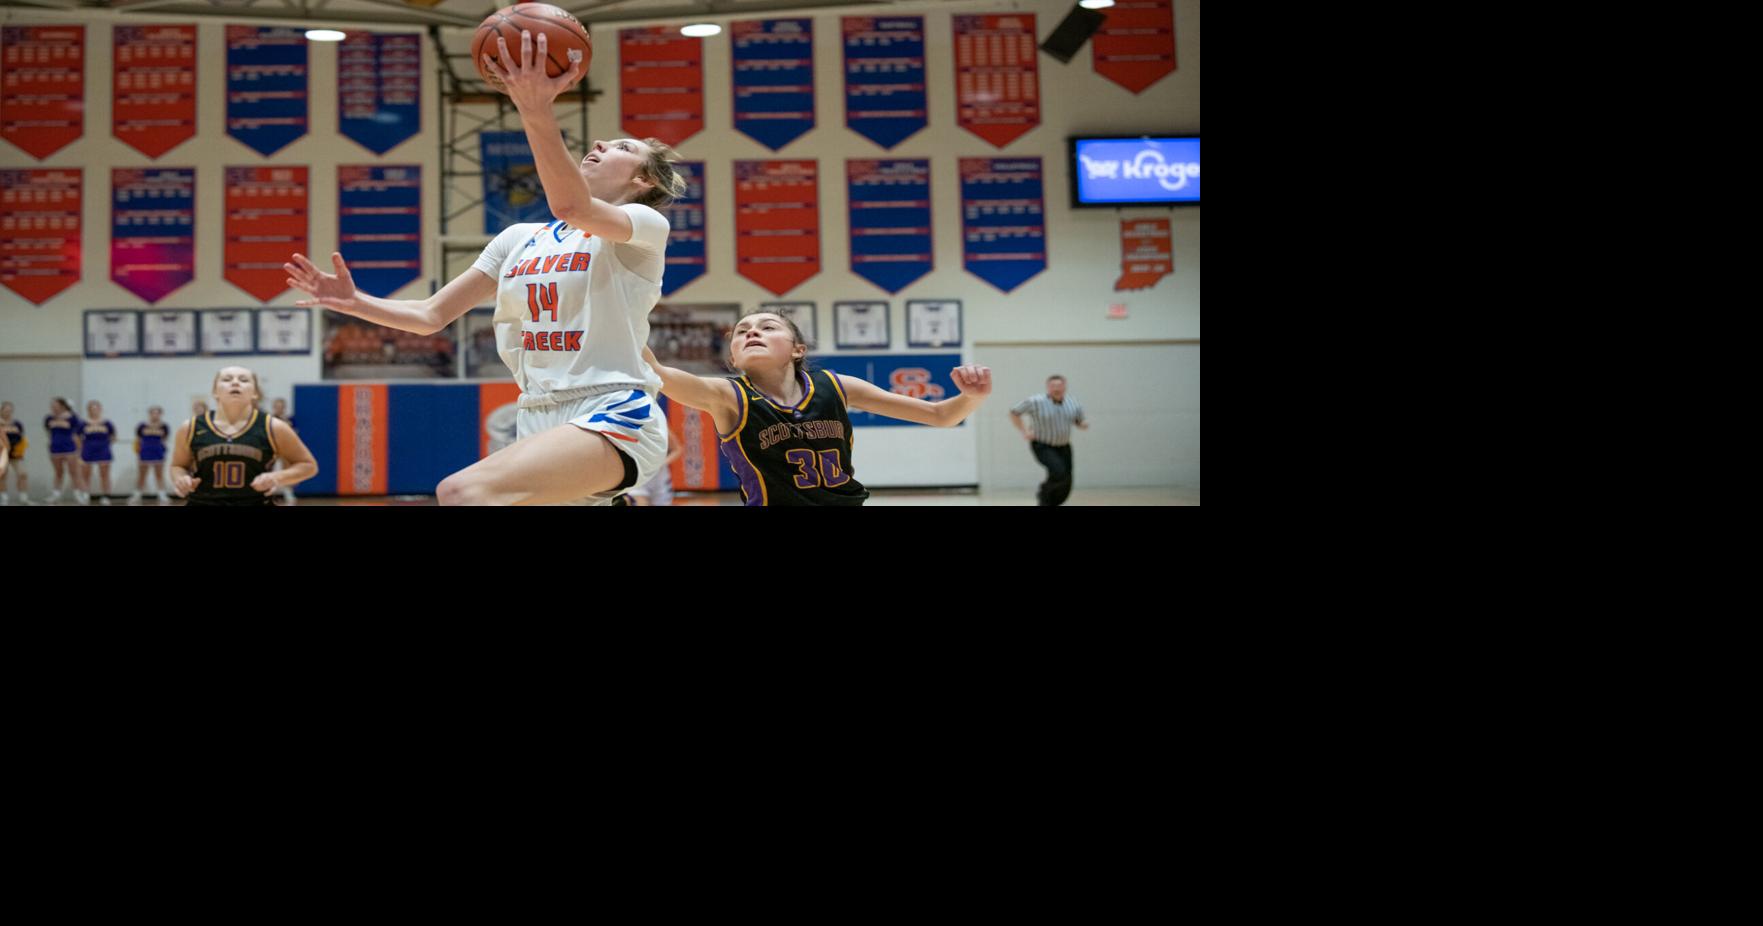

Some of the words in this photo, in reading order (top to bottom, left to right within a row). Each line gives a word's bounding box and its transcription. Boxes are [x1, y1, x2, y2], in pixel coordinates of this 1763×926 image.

[504, 252, 591, 278] SILVER
[526, 282, 558, 322] 14
[521, 331, 584, 351] REEK
[213, 461, 245, 488] 10
[785, 448, 850, 489] 30
